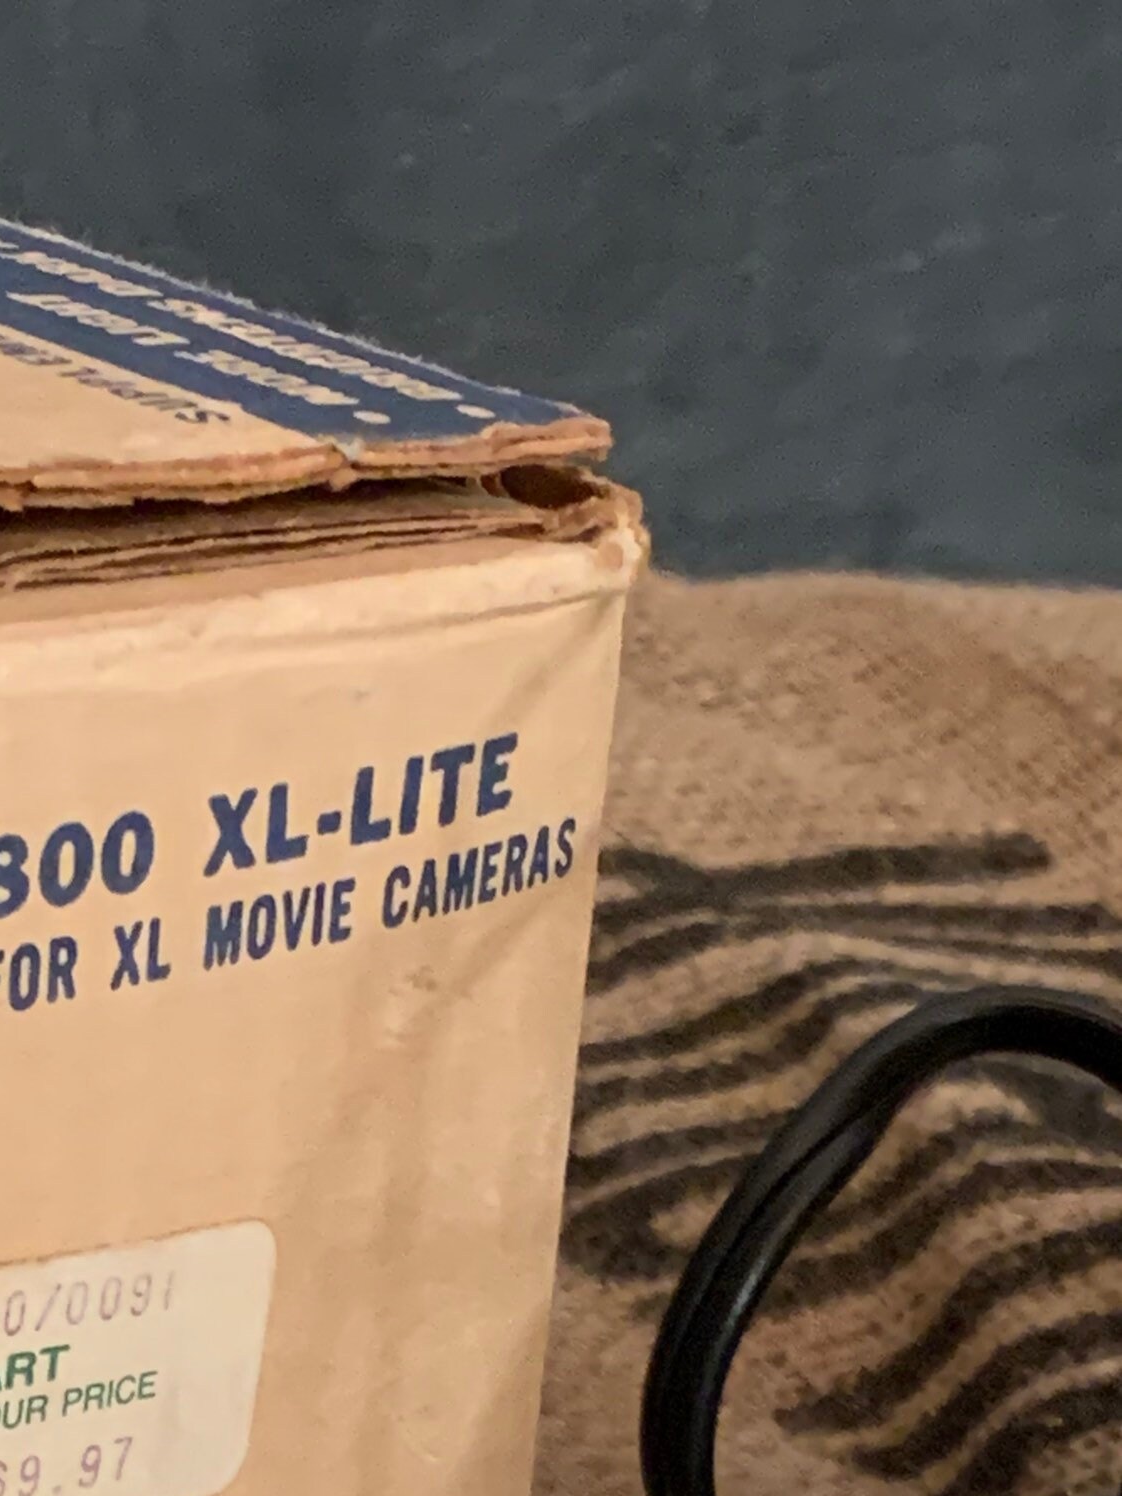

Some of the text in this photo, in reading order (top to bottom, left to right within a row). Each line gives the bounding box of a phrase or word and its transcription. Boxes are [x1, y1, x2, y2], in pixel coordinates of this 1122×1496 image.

[204, 733, 518, 877] XL-LITE
[111, 918, 170, 990] XL
[204, 878, 355, 970] MOVIE
[383, 818, 576, 929] CAMERAS
[61, 1371, 158, 1418] PRICE
